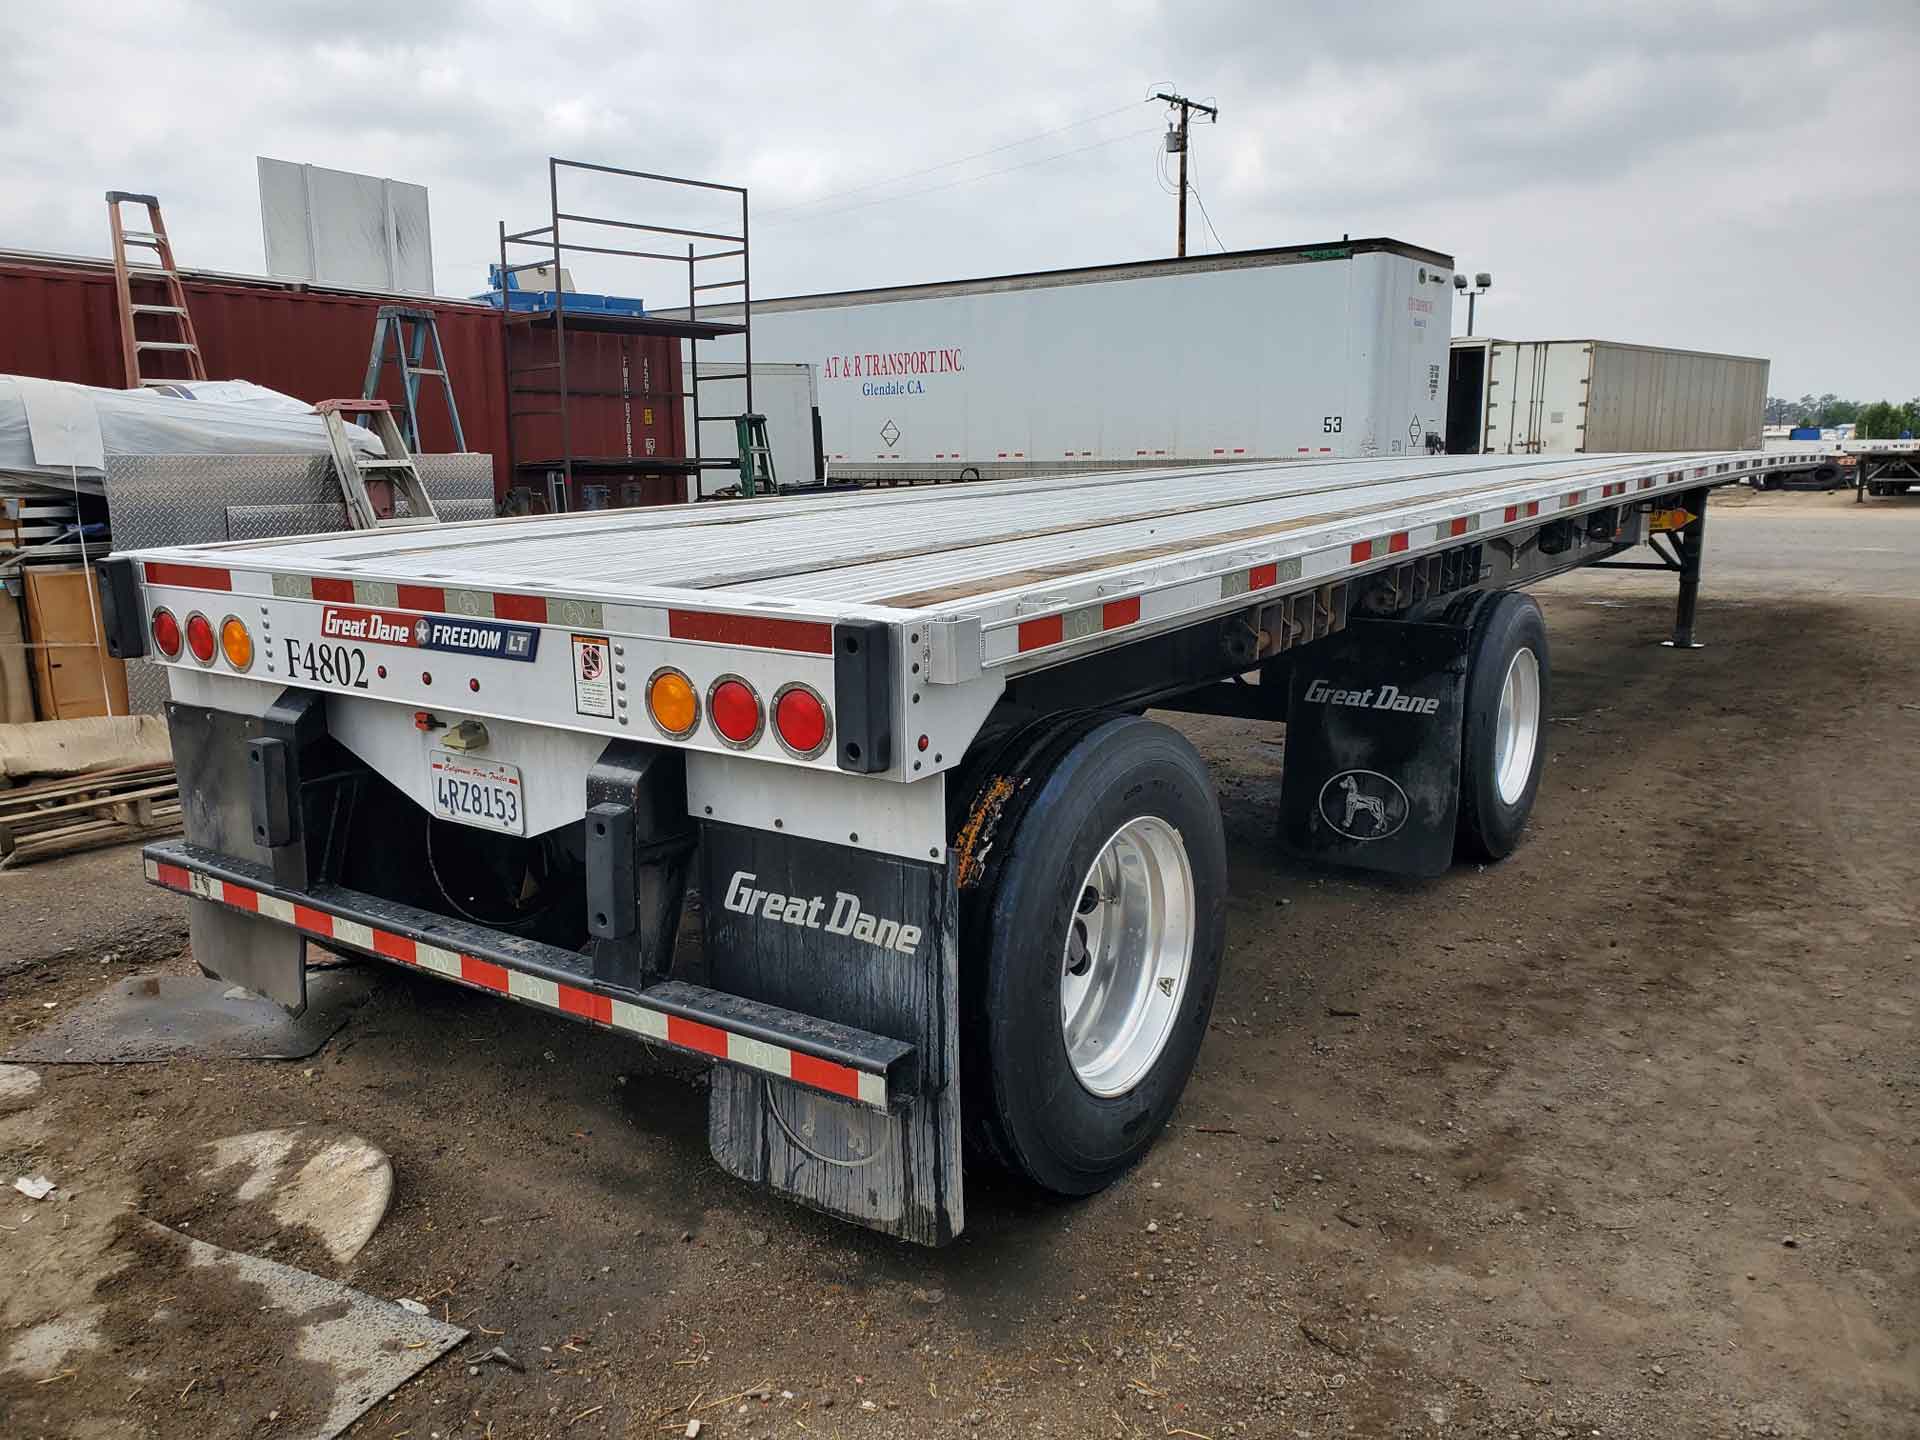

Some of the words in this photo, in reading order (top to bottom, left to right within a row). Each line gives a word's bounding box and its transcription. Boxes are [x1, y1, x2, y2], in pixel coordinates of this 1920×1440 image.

[824, 356, 840, 378] AT
[843, 356, 851, 377] &
[854, 355, 862, 377] R
[865, 350, 937, 377] TRANSPORT
[939, 348, 965, 373] INC.
[862, 382, 905, 397] Glendale
[907, 381, 926, 395] CA.
[1323, 416, 1342, 433] 53
[324, 607, 368, 639] Great
[368, 614, 409, 644] Dane
[432, 624, 502, 651] FREEDOM
[508, 634, 528, 653] LT
[284, 638, 369, 690] F4802
[1304, 679, 1374, 708] Great
[1371, 685, 1440, 715] Dane
[438, 777, 517, 822] 4RZ8153
[723, 870, 826, 929] Great
[824, 890, 922, 955] Dane
